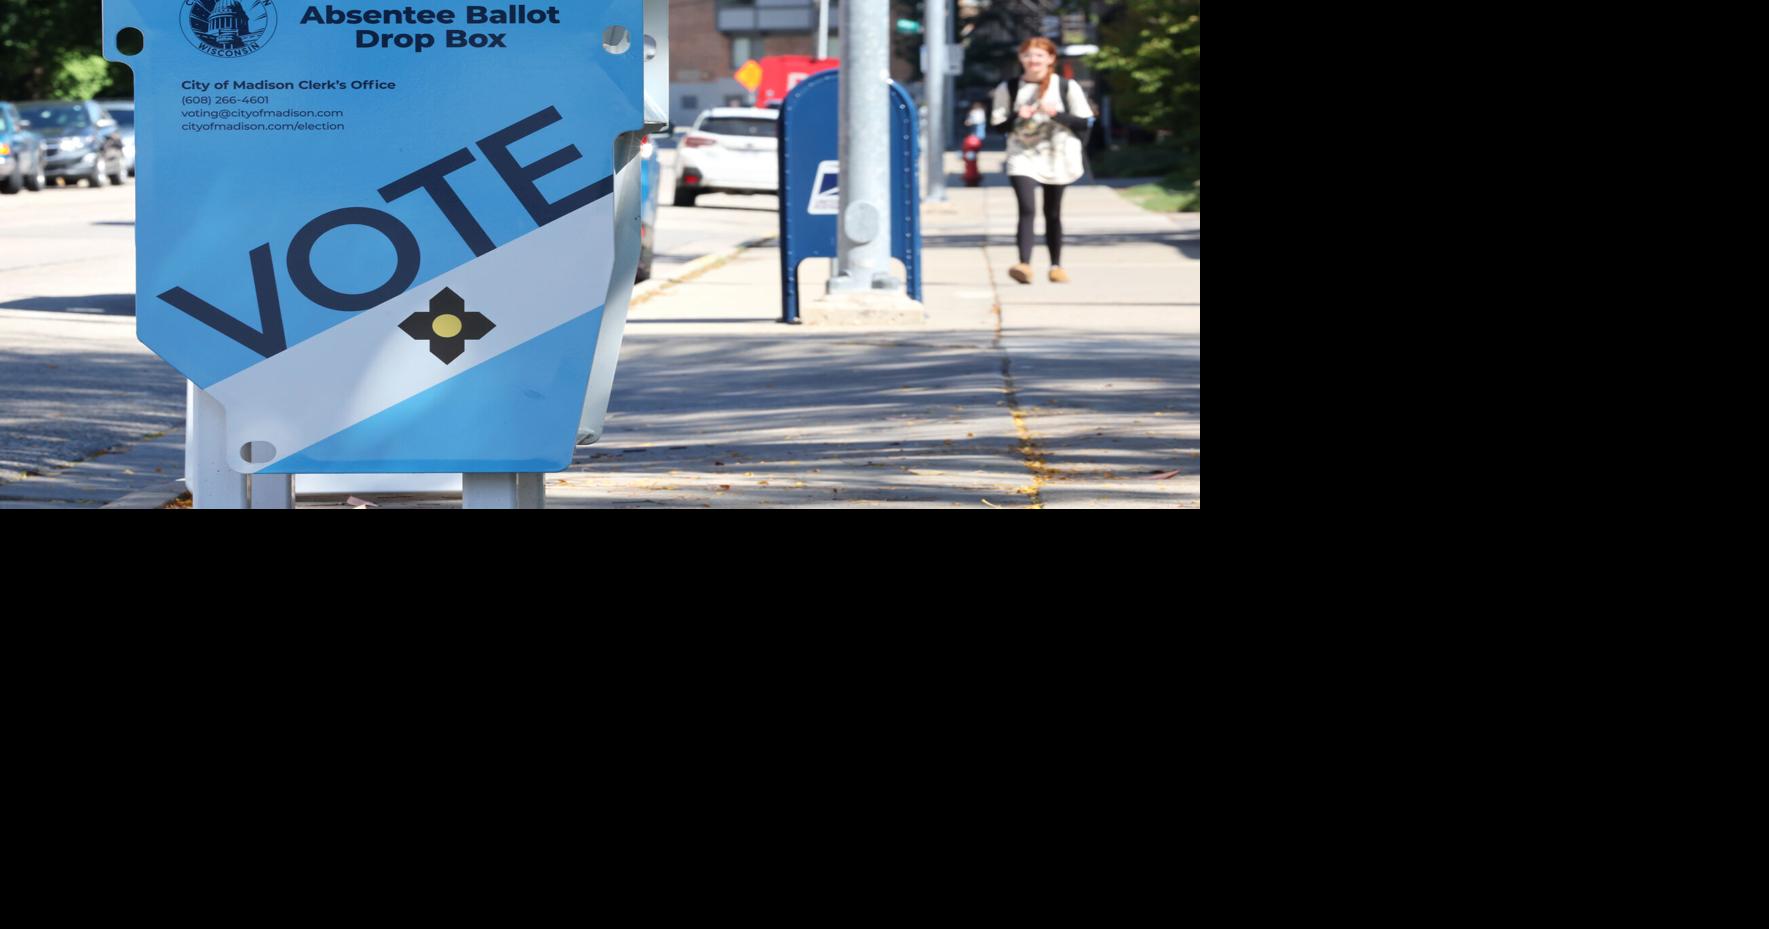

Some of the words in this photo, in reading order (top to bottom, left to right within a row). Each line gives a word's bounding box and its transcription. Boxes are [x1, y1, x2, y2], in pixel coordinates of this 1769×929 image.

[300, 5, 455, 25] Absentee
[466, 4, 560, 25] Ballot
[355, 29, 434, 52] Drop
[446, 29, 507, 48] Box
[198, 42, 260, 57] WISCONSIN
[181, 79, 210, 92] City
[214, 79, 229, 90] of
[233, 79, 294, 90] Madison
[298, 79, 347, 90] Clerk's
[351, 79, 396, 90] Office
[181, 95, 211, 106] (608)
[215, 95, 269, 105] 266-4601
[181, 108, 344, 119] voting@cityofmadison.com
[181, 121, 345, 132] cityofmadison.com/election
[156, 105, 614, 359] VOTE
